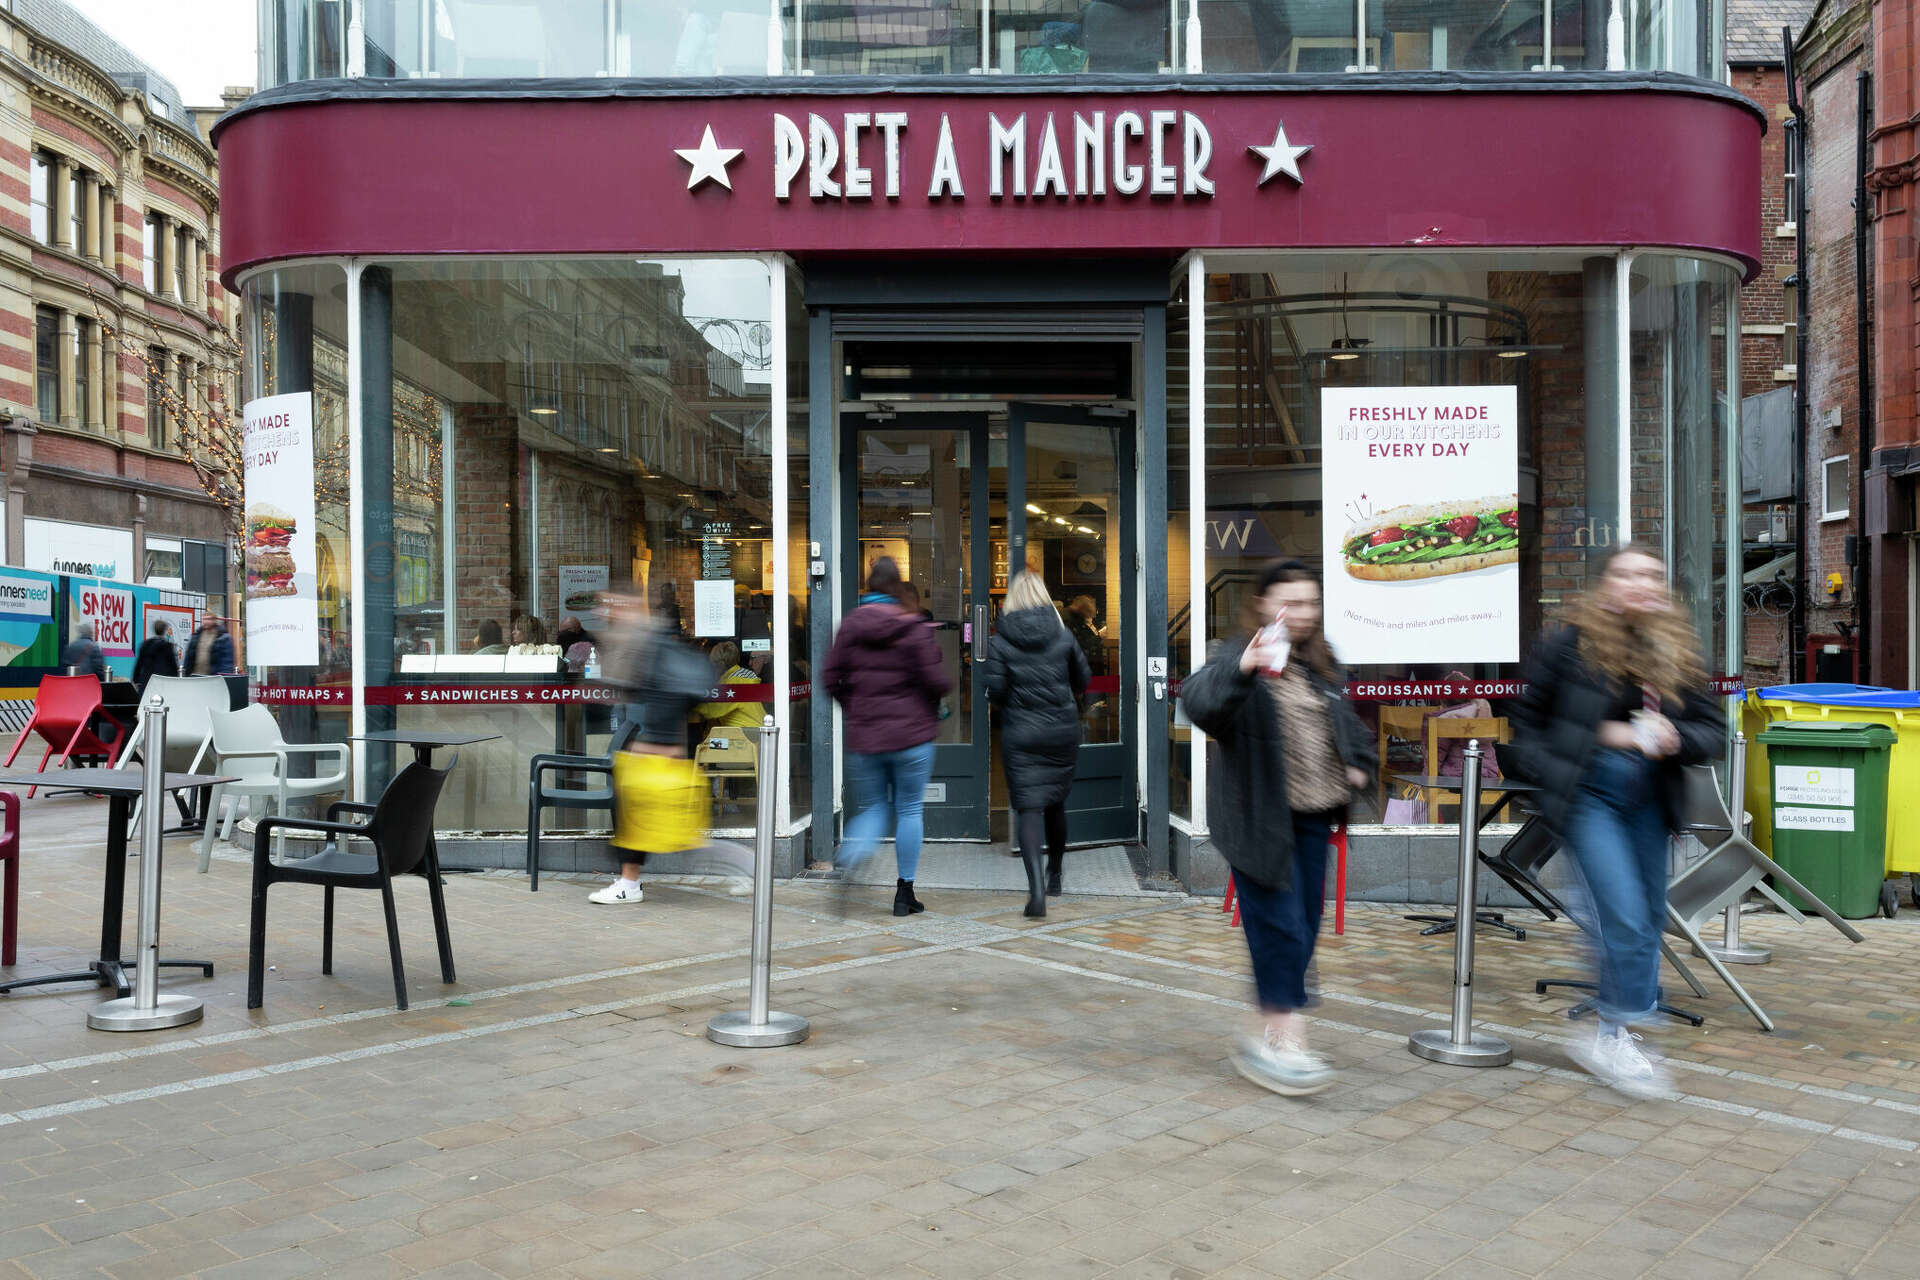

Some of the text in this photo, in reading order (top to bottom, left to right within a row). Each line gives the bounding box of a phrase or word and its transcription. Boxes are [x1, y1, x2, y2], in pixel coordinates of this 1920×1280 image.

[773, 109, 1215, 198] PRET A MANGER
[1349, 406, 1489, 421] FRESHLY MADE
[258, 413, 290, 431] MADE
[1338, 423, 1501, 440] IN OUR KITCHENS
[1368, 442, 1470, 457] EVERY DAY
[258, 450, 279, 467] DAY
[53, 560, 116, 578] runnersneed
[0, 585, 48, 601] nnersneed
[82, 592, 125, 617] SNOW
[1363, 616, 1385, 628] miles
[1387, 622, 1404, 630] and
[1405, 619, 1427, 630] miles
[1428, 617, 1445, 627] and
[1447, 614, 1469, 625] miles
[94, 619, 129, 643] ROCK
[269, 688, 287, 699] HOT
[290, 689, 330, 700] WRAPS
[420, 689, 519, 701] SANDWICHES
[1356, 683, 1530, 696] CROISSANTS COOKIE
[1782, 815, 1808, 823] GLASS
